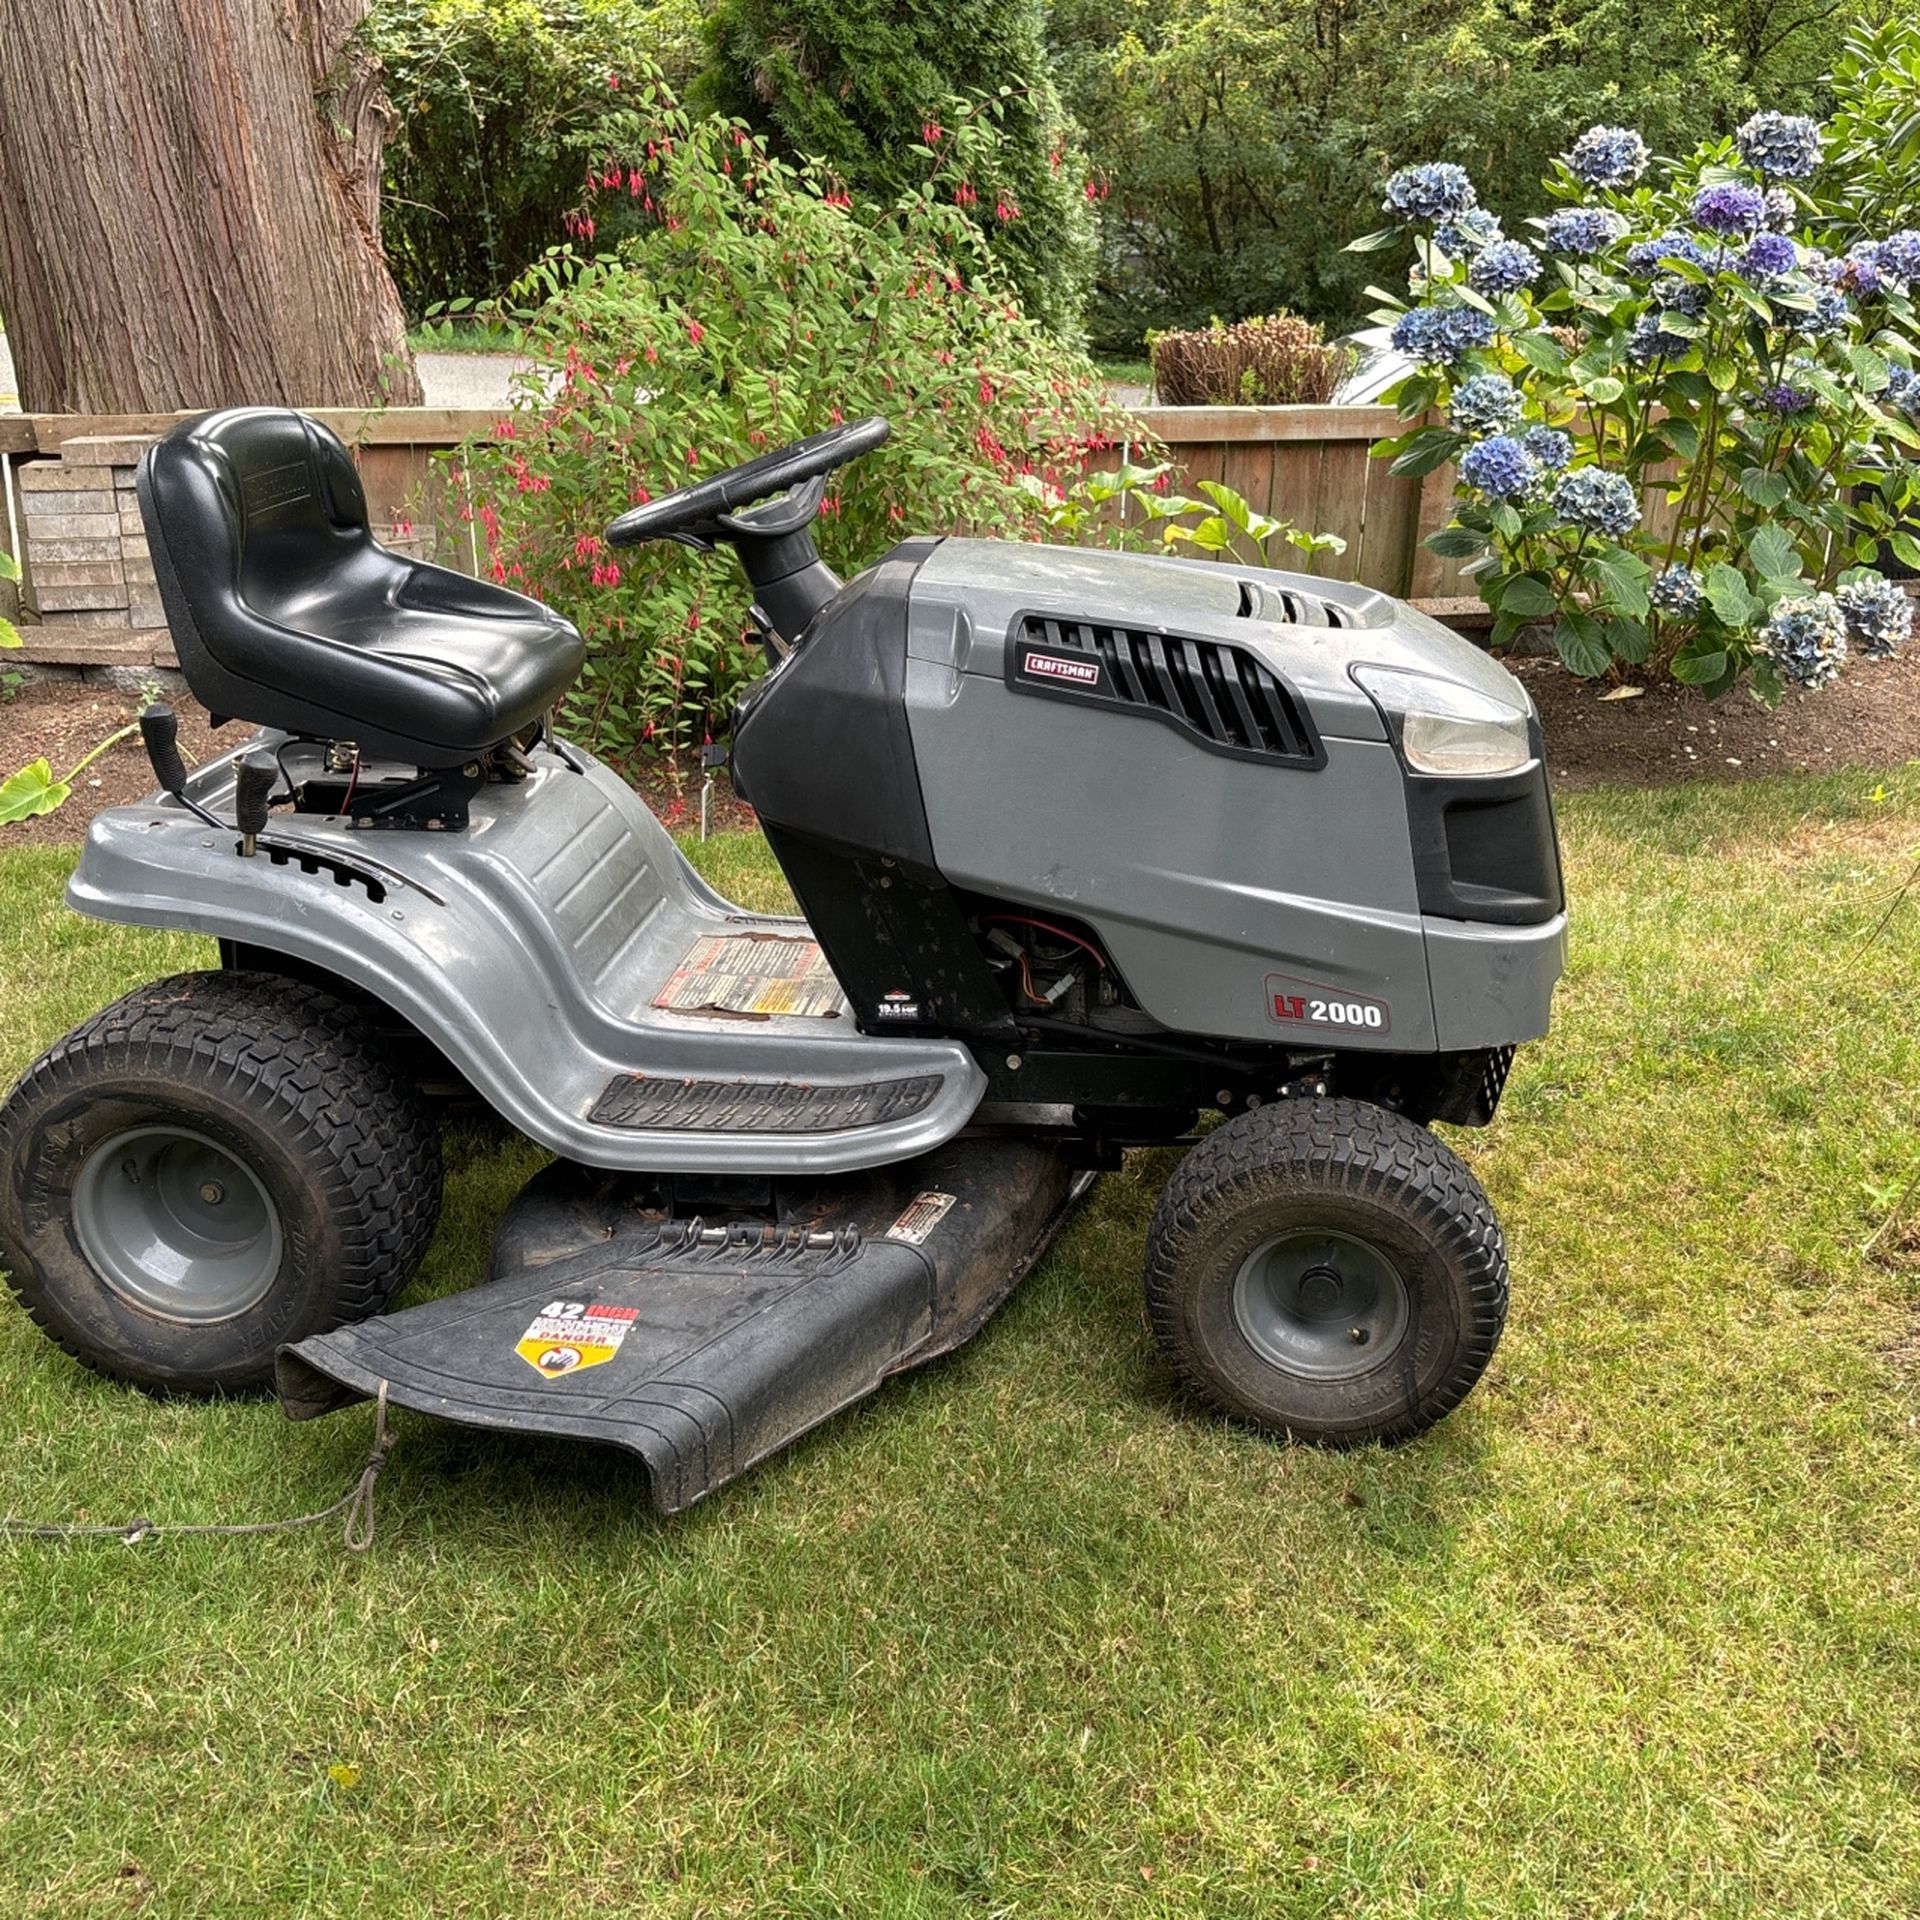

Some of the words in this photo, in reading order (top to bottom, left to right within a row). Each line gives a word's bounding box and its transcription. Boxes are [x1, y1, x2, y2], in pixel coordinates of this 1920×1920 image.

[1030, 658, 1094, 679] CRAFTSMAN
[1274, 995, 1306, 1019] LT
[1309, 1000, 1382, 1027] 2000
[540, 1301, 585, 1320] 42
[585, 1304, 640, 1320] INCH
[539, 1331, 607, 1344] DANGER
